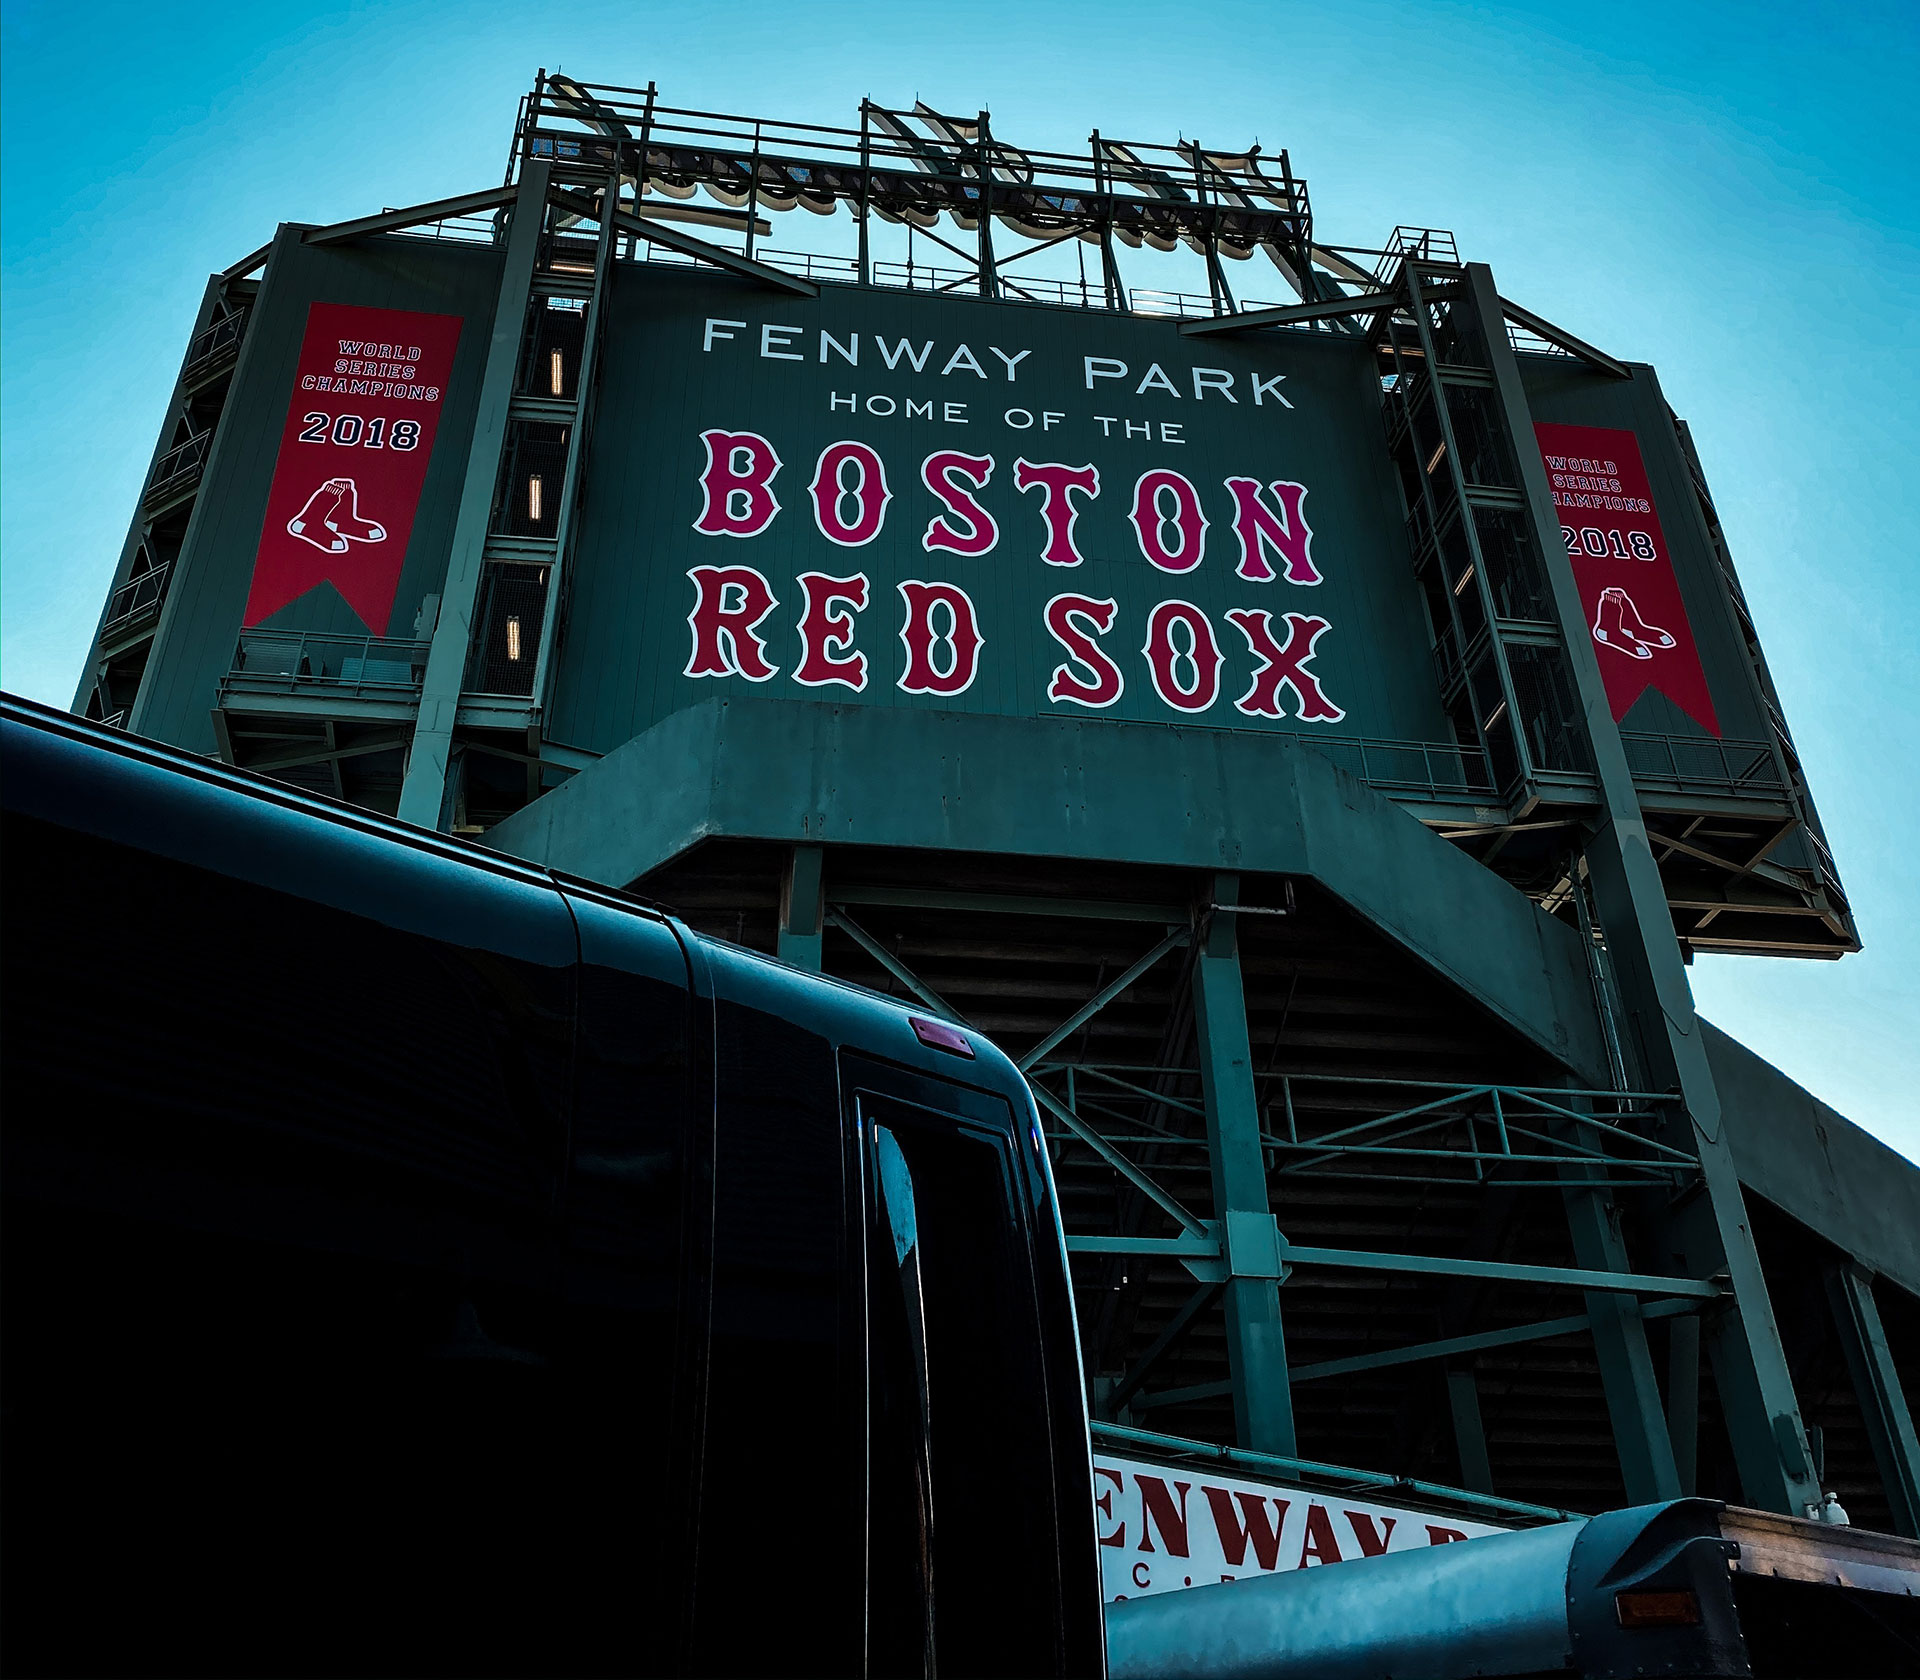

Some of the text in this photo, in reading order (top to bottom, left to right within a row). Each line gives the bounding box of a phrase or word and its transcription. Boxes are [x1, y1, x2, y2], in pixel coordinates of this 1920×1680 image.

[334, 359, 416, 380] SERIES
[338, 340, 421, 362] WORLD
[703, 318, 1294, 409] FENWAY PARK
[301, 375, 439, 401] CHAMPIONS
[298, 412, 421, 451] 2018
[829, 391, 1186, 444] HOME OF THE
[1545, 455, 1618, 475] WORLD
[1552, 474, 1622, 493] SERIES
[692, 429, 1325, 586] BOSTON
[1551, 492, 1651, 513] HAMPIONS
[1560, 525, 1657, 562] 2018
[683, 565, 1346, 724] RED SOX
[1094, 1467, 1396, 1570] ENWAY
